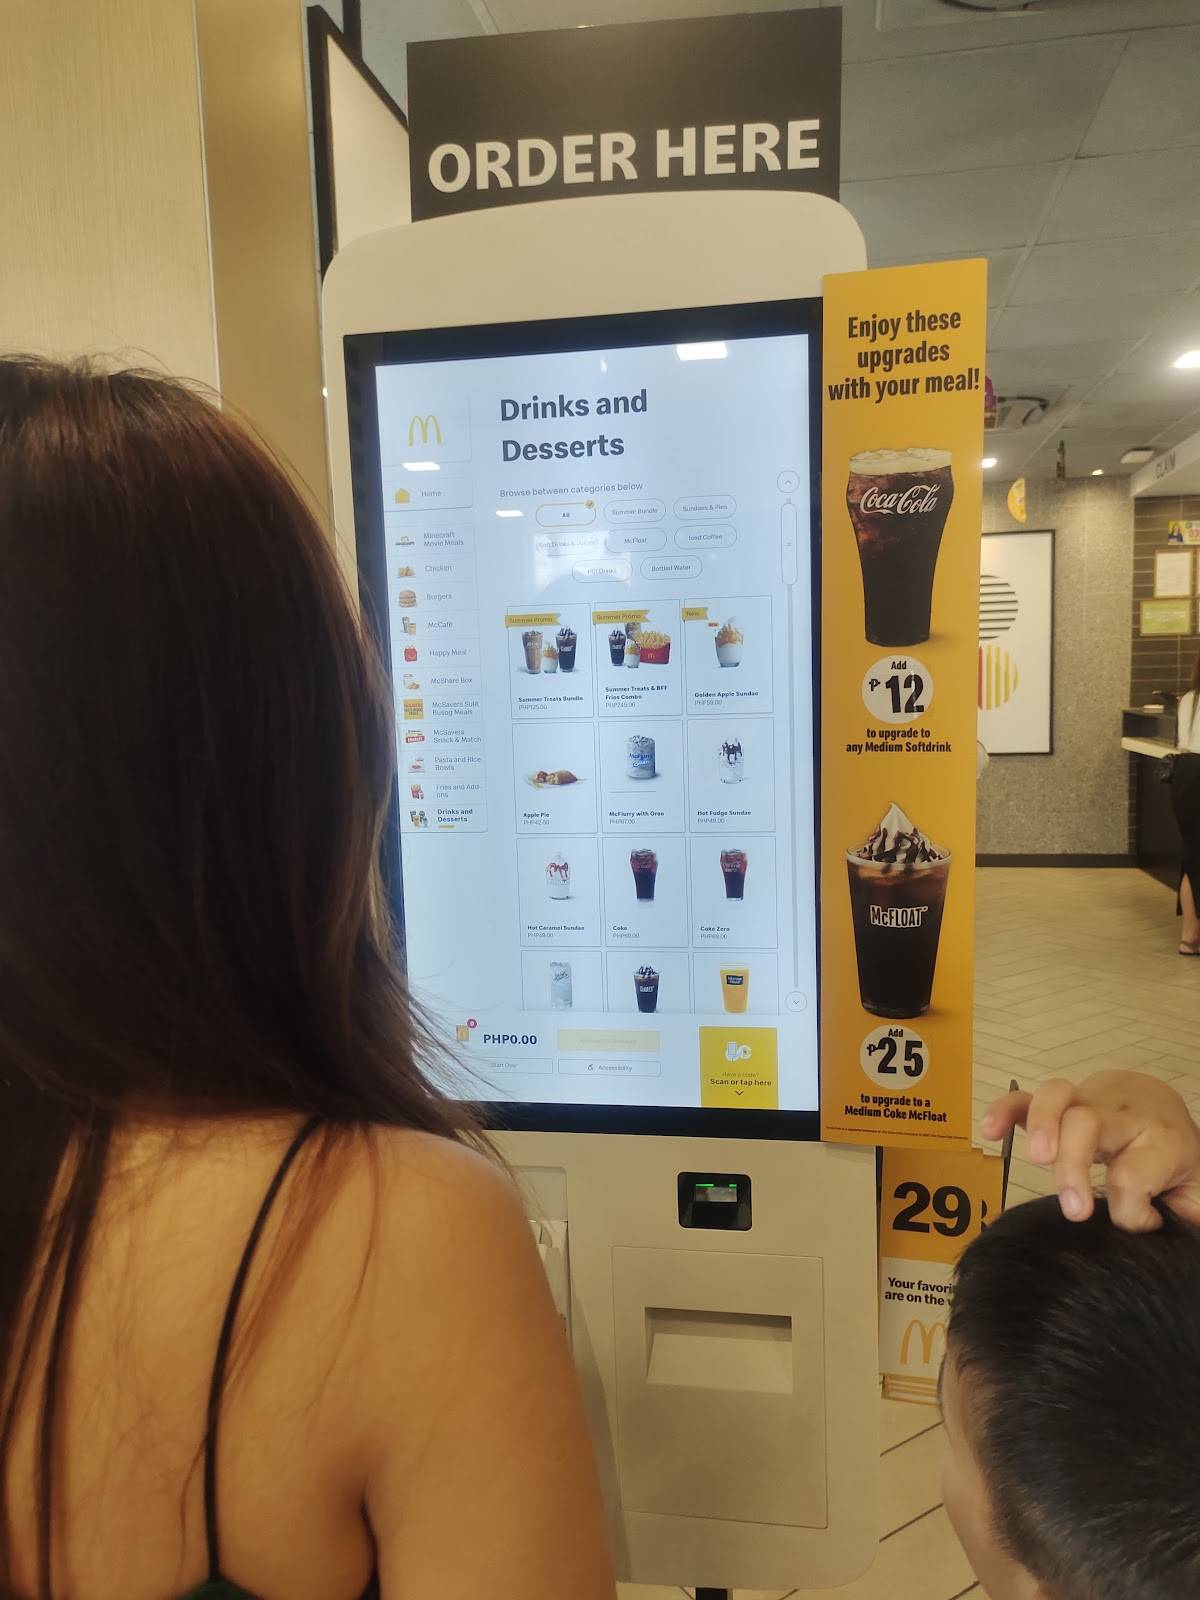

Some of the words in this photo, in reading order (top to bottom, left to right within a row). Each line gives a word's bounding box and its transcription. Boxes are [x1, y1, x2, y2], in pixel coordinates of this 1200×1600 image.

[428, 131, 638, 193] ORDER
[656, 119, 820, 178] HERE
[848, 314, 901, 342] Enjoy
[906, 310, 961, 333] these
[857, 341, 949, 372] upgrades
[829, 377, 870, 401] with
[875, 378, 920, 403] your
[925, 368, 980, 393] meal!
[501, 394, 590, 421] Drinks
[596, 389, 647, 415] and
[502, 434, 625, 462] Desserts
[421, 490, 441, 498] Home
[500, 488, 531, 498] Browse
[532, 486, 568, 496] between
[570, 483, 616, 495] categories
[617, 481, 643, 491] below
[860, 484, 941, 515] Coca-Cola
[611, 508, 637, 516] Summer
[637, 506, 658, 515] Bundle
[423, 531, 456, 539] Minecraft
[444, 539, 464, 547] Meals
[424, 564, 452, 572] Chicken
[426, 593, 452, 601] Burgers
[429, 650, 450, 658] Happy
[890, 660, 907, 670] Add
[430, 677, 460, 685] McShare
[717, 691, 735, 699] Apple
[432, 709, 453, 717] Busog
[433, 736, 454, 744] Snack
[866, 728, 877, 738] to
[878, 728, 918, 741] upgrade
[920, 728, 931, 738] to
[846, 743, 863, 756] any
[865, 742, 903, 753] Medium
[905, 742, 952, 753] Softdrink
[870, 905, 928, 928] McFLOAT
[887, 1028, 904, 1038] Add
[483, 1034, 538, 1045] PHP0.00
[598, 1064, 633, 1072] Accessibility
[740, 1079, 753, 1087] tap
[860, 1093, 871, 1103] to
[872, 1095, 911, 1108] upgrade
[913, 1096, 923, 1107] to
[924, 1099, 931, 1108] a
[844, 1105, 882, 1117] Medium
[883, 1108, 907, 1120] Coke
[908, 1109, 947, 1123] McFloat
[892, 1181, 972, 1237] 29
[888, 1277, 915, 1290] Your
[917, 1280, 953, 1294] favori
[884, 1291, 905, 1301] are
[906, 1292, 922, 1303] on
[924, 1294, 945, 1306] the
